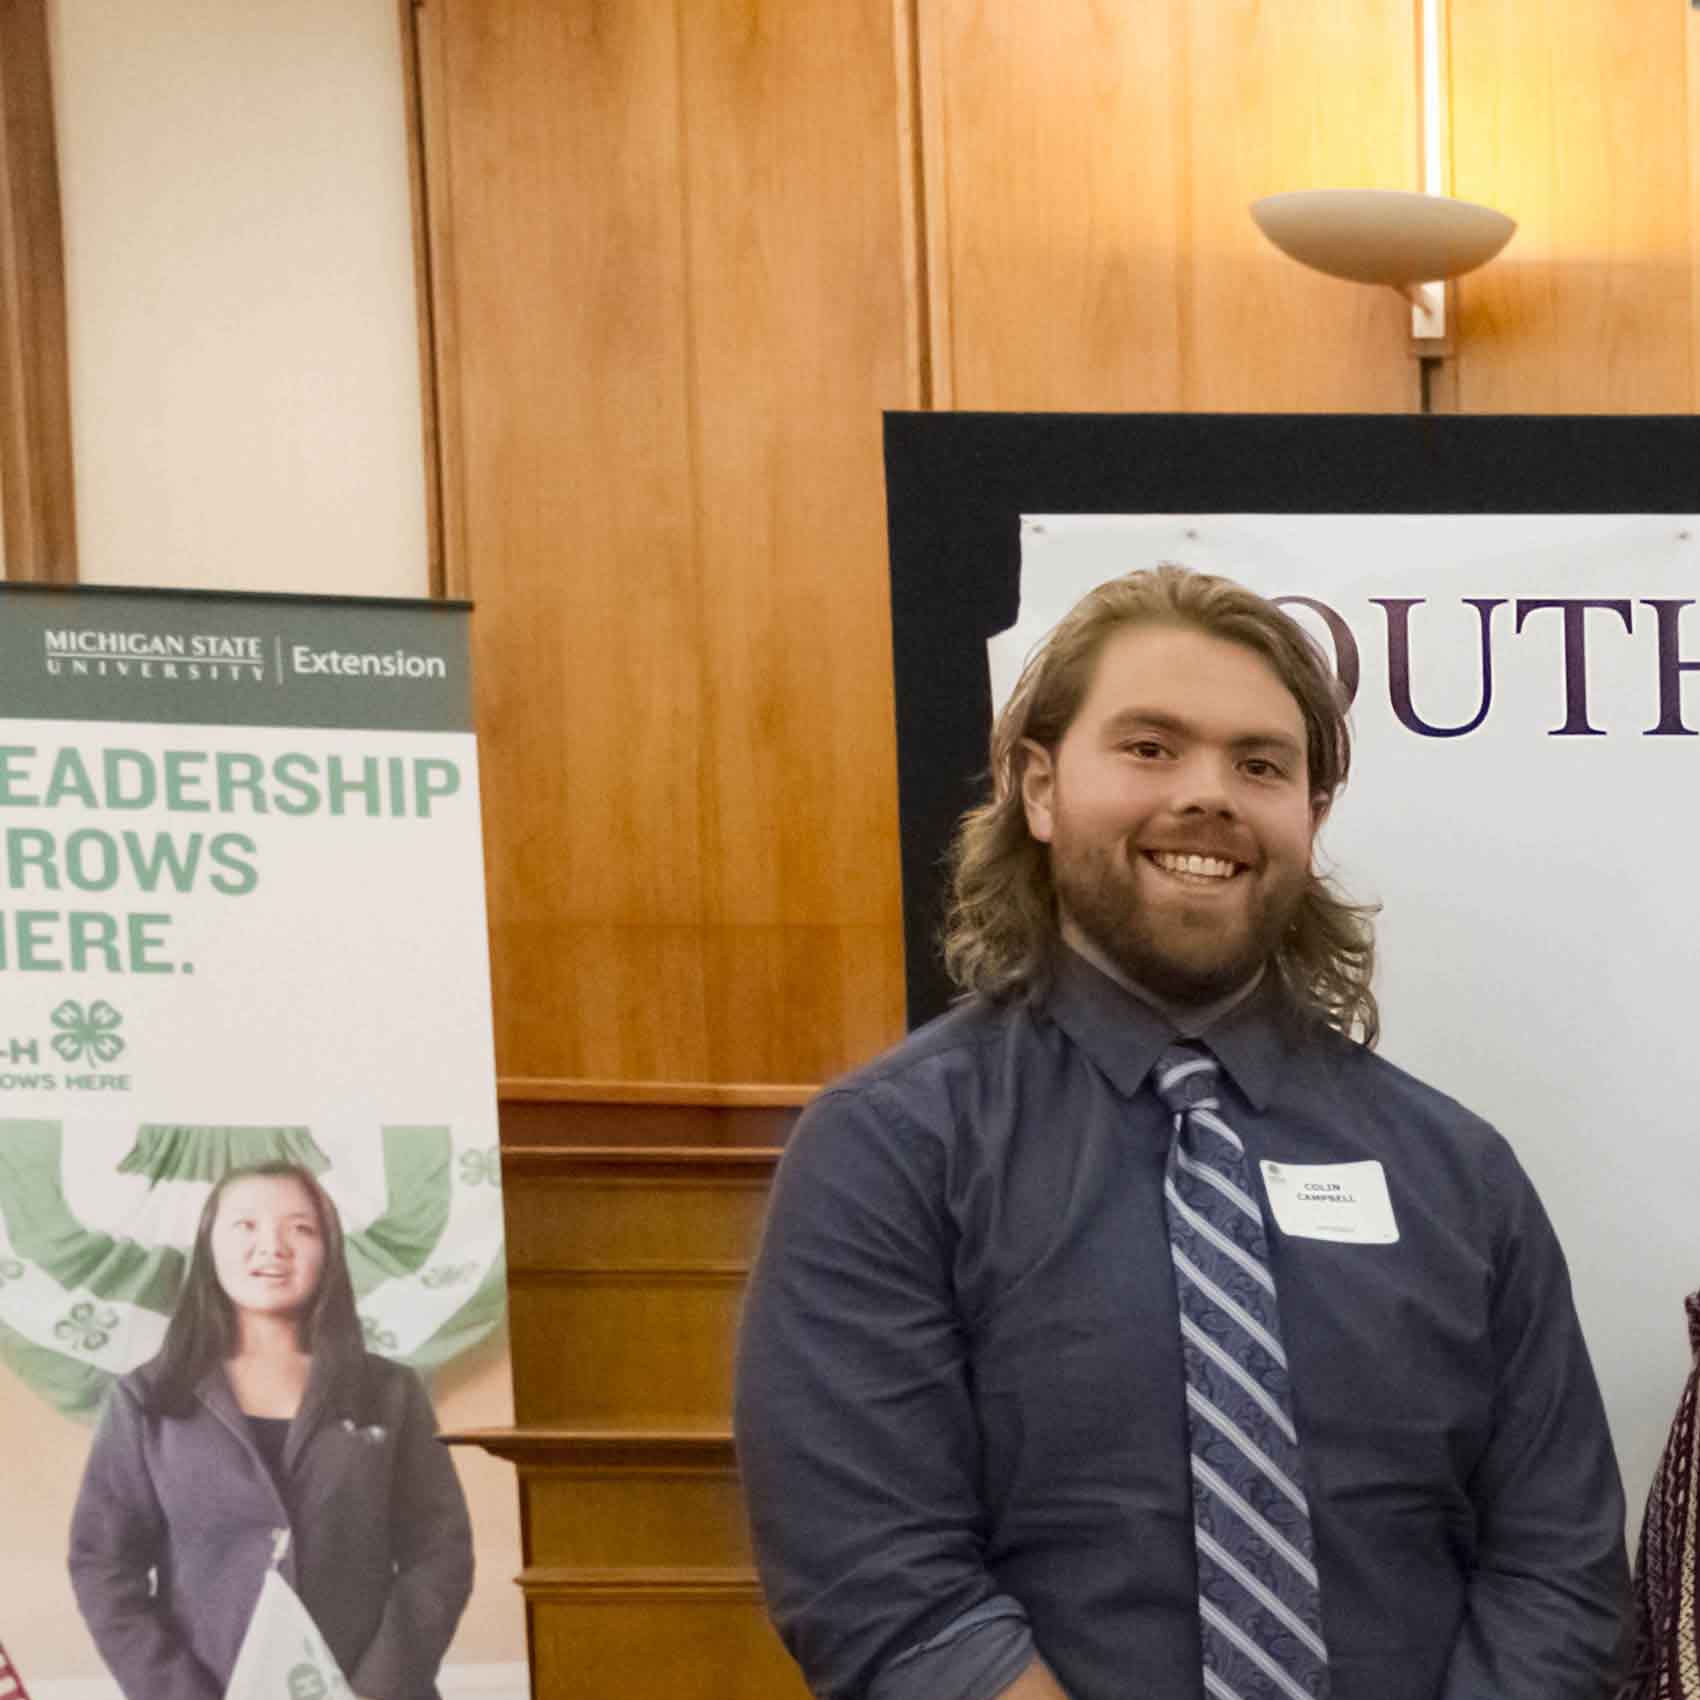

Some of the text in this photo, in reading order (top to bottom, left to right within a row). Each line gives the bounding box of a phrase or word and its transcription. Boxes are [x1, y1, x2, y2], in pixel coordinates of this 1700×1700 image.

[44, 630, 263, 658] MICHIGAN STATE
[46, 659, 264, 682] UNIVERSITY
[292, 645, 447, 678] Extension
[0, 909, 195, 976] ERE.
[65, 1073, 132, 1091] HERE
